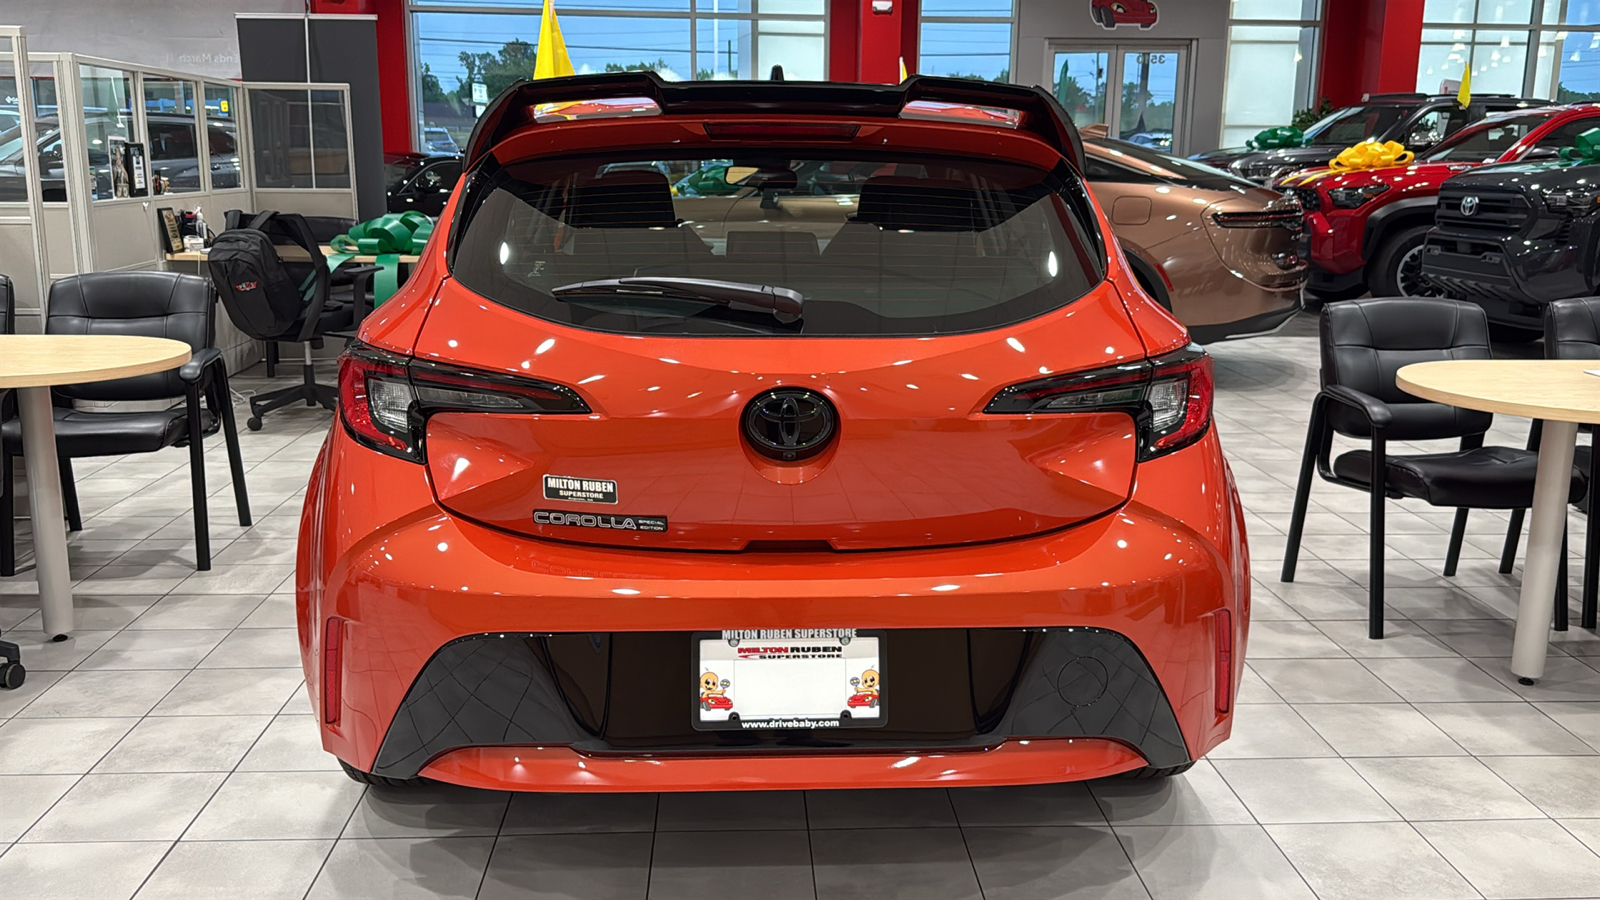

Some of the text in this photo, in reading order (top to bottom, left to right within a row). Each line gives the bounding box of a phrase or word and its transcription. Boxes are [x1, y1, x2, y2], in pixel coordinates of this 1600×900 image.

[548, 477, 613, 493] MILTON RUBEN
[559, 490, 604, 499] SUPERSTORE
[533, 511, 637, 530] COROLLA
[721, 628, 857, 640] MILTON RUBEN SUPERSTORE
[737, 646, 789, 654] MILTON
[741, 719, 839, 729] www.drivebaby.com
